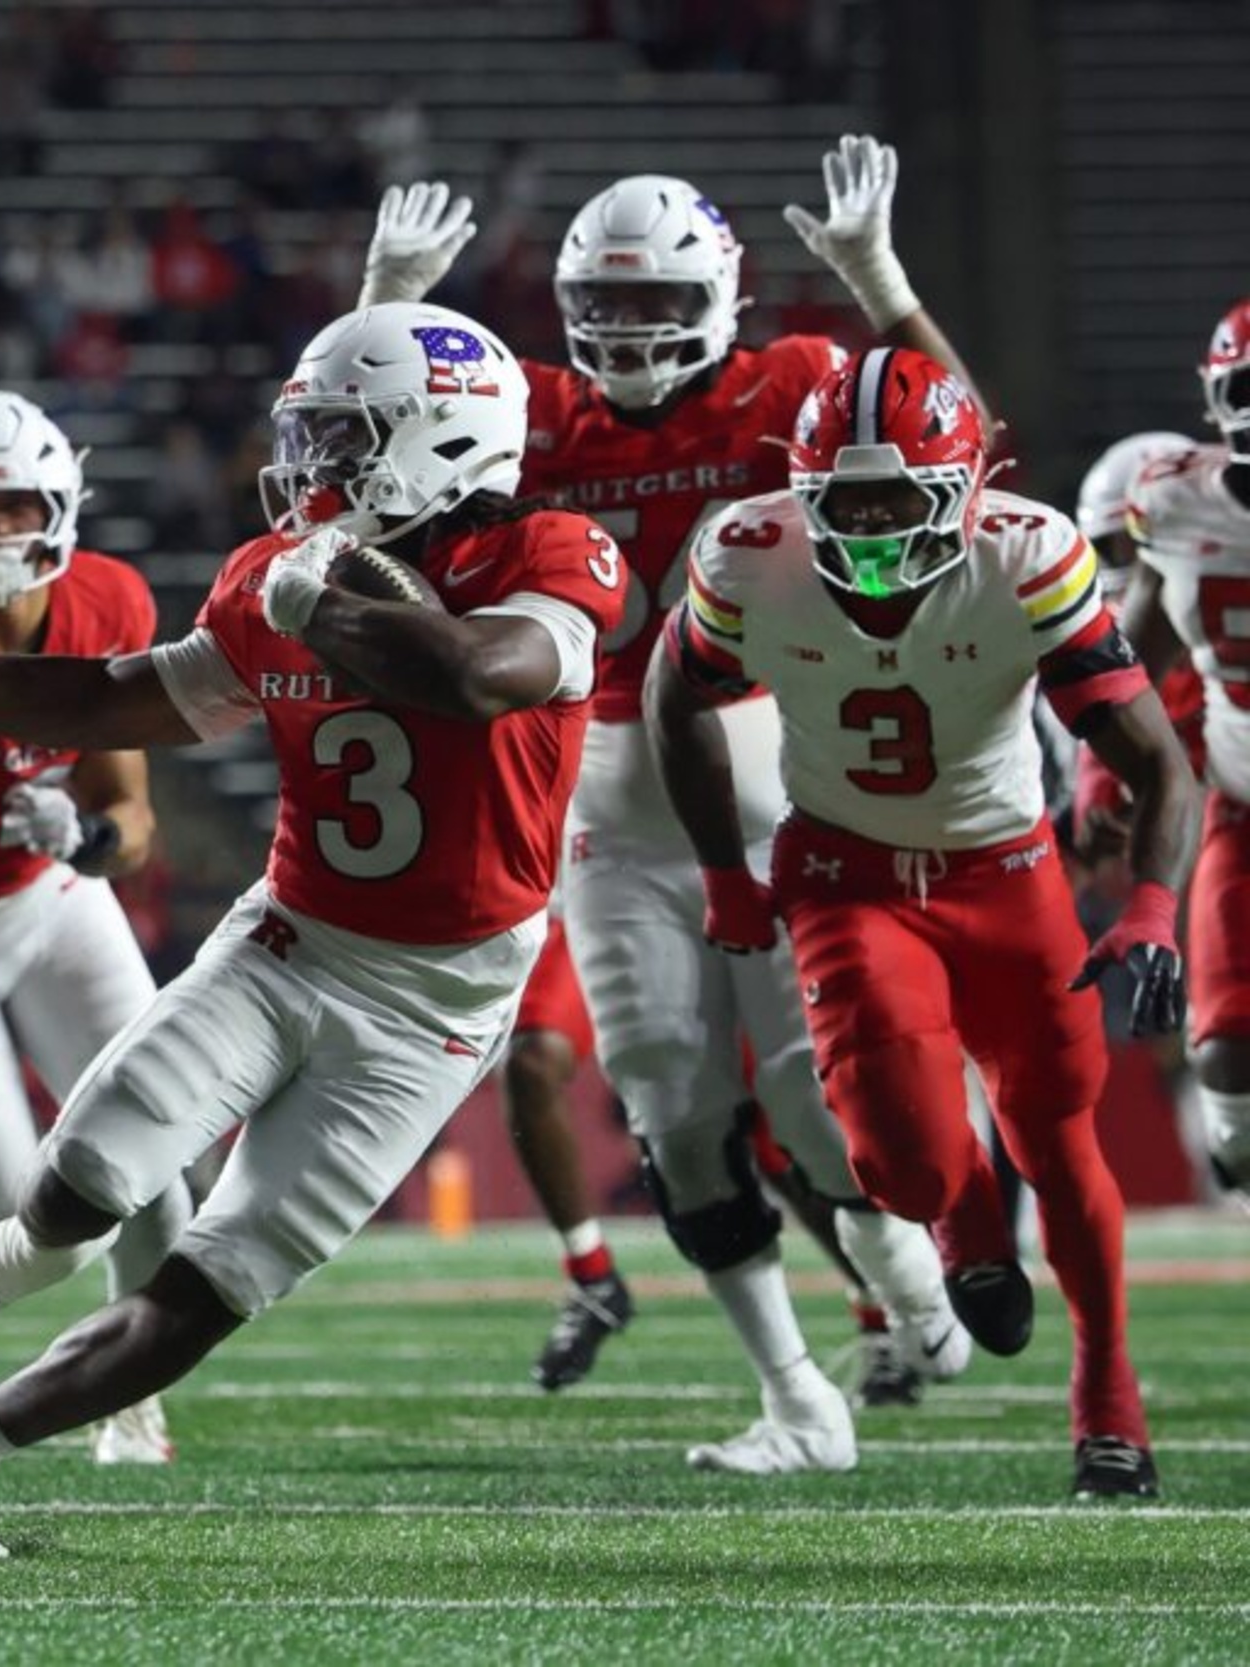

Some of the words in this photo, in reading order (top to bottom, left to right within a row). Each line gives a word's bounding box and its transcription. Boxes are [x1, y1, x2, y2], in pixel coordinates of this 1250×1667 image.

[410, 327, 500, 397] R
[717, 521, 782, 549] 3
[980, 513, 1037, 534] 3
[587, 527, 620, 589] 3
[840, 684, 938, 796] 3
[313, 709, 424, 880] 3
[246, 911, 299, 961] R
